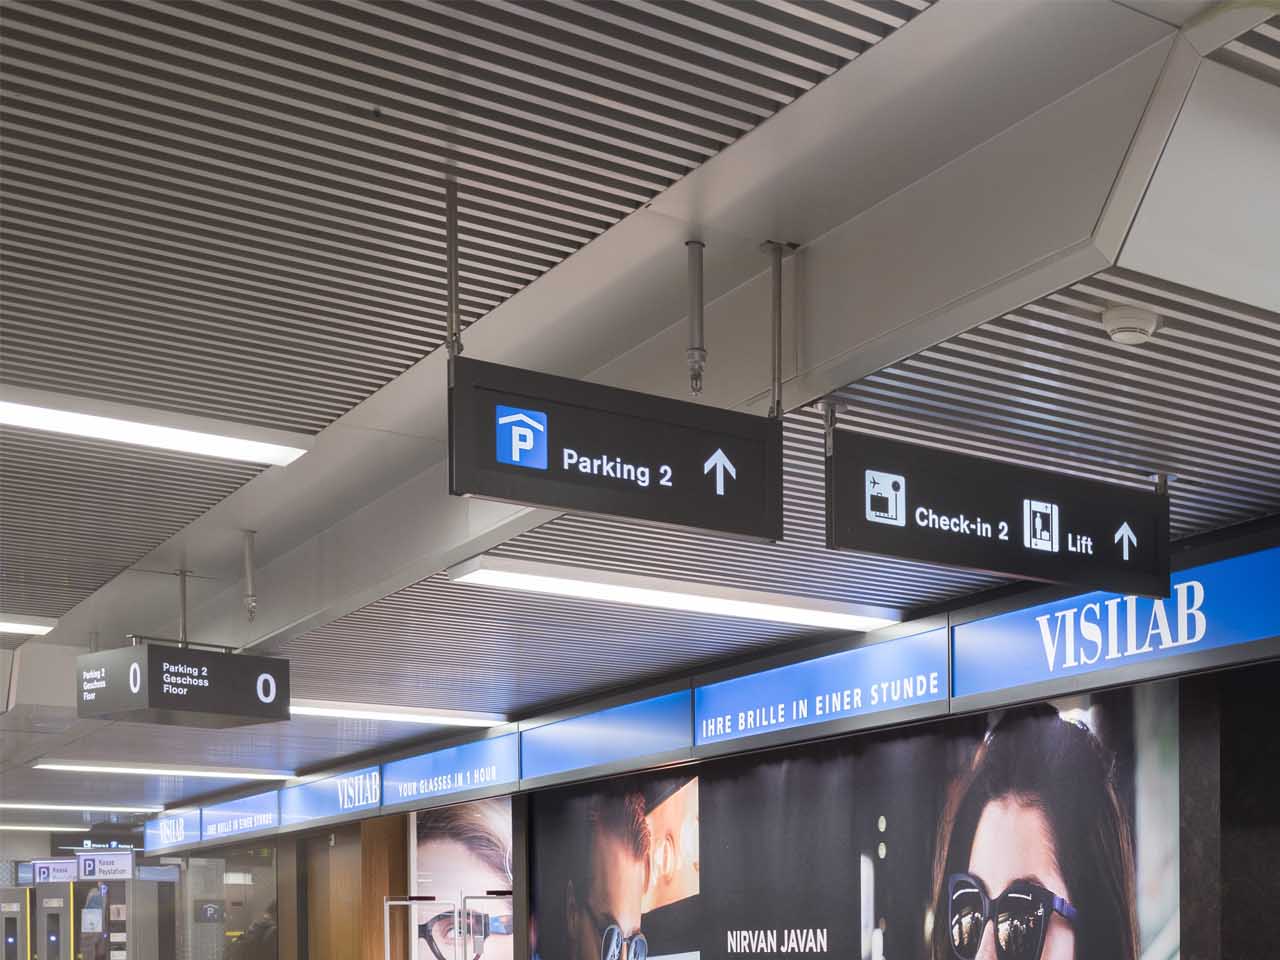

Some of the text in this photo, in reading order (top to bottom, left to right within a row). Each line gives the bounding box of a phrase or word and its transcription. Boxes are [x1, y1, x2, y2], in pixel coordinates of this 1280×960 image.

[562, 448, 673, 487] Parking 2
[914, 506, 1009, 541] Check-in 2
[1068, 533, 1093, 555] Lift
[1035, 580, 1207, 673] VISILAB
[129, 662, 141, 694] 0
[163, 662, 208, 676] Parking 2
[163, 673, 209, 687] Geschoss
[163, 684, 188, 695] Floor
[256, 673, 277, 704] 0
[702, 672, 939, 738] IHRE BRILLE IN EINER STUNDE
[336, 772, 380, 809] VISILAB
[398, 766, 497, 798] YOUR GLASSES IN 1 HOUR
[727, 928, 828, 953] NIRVAN JAVAN
